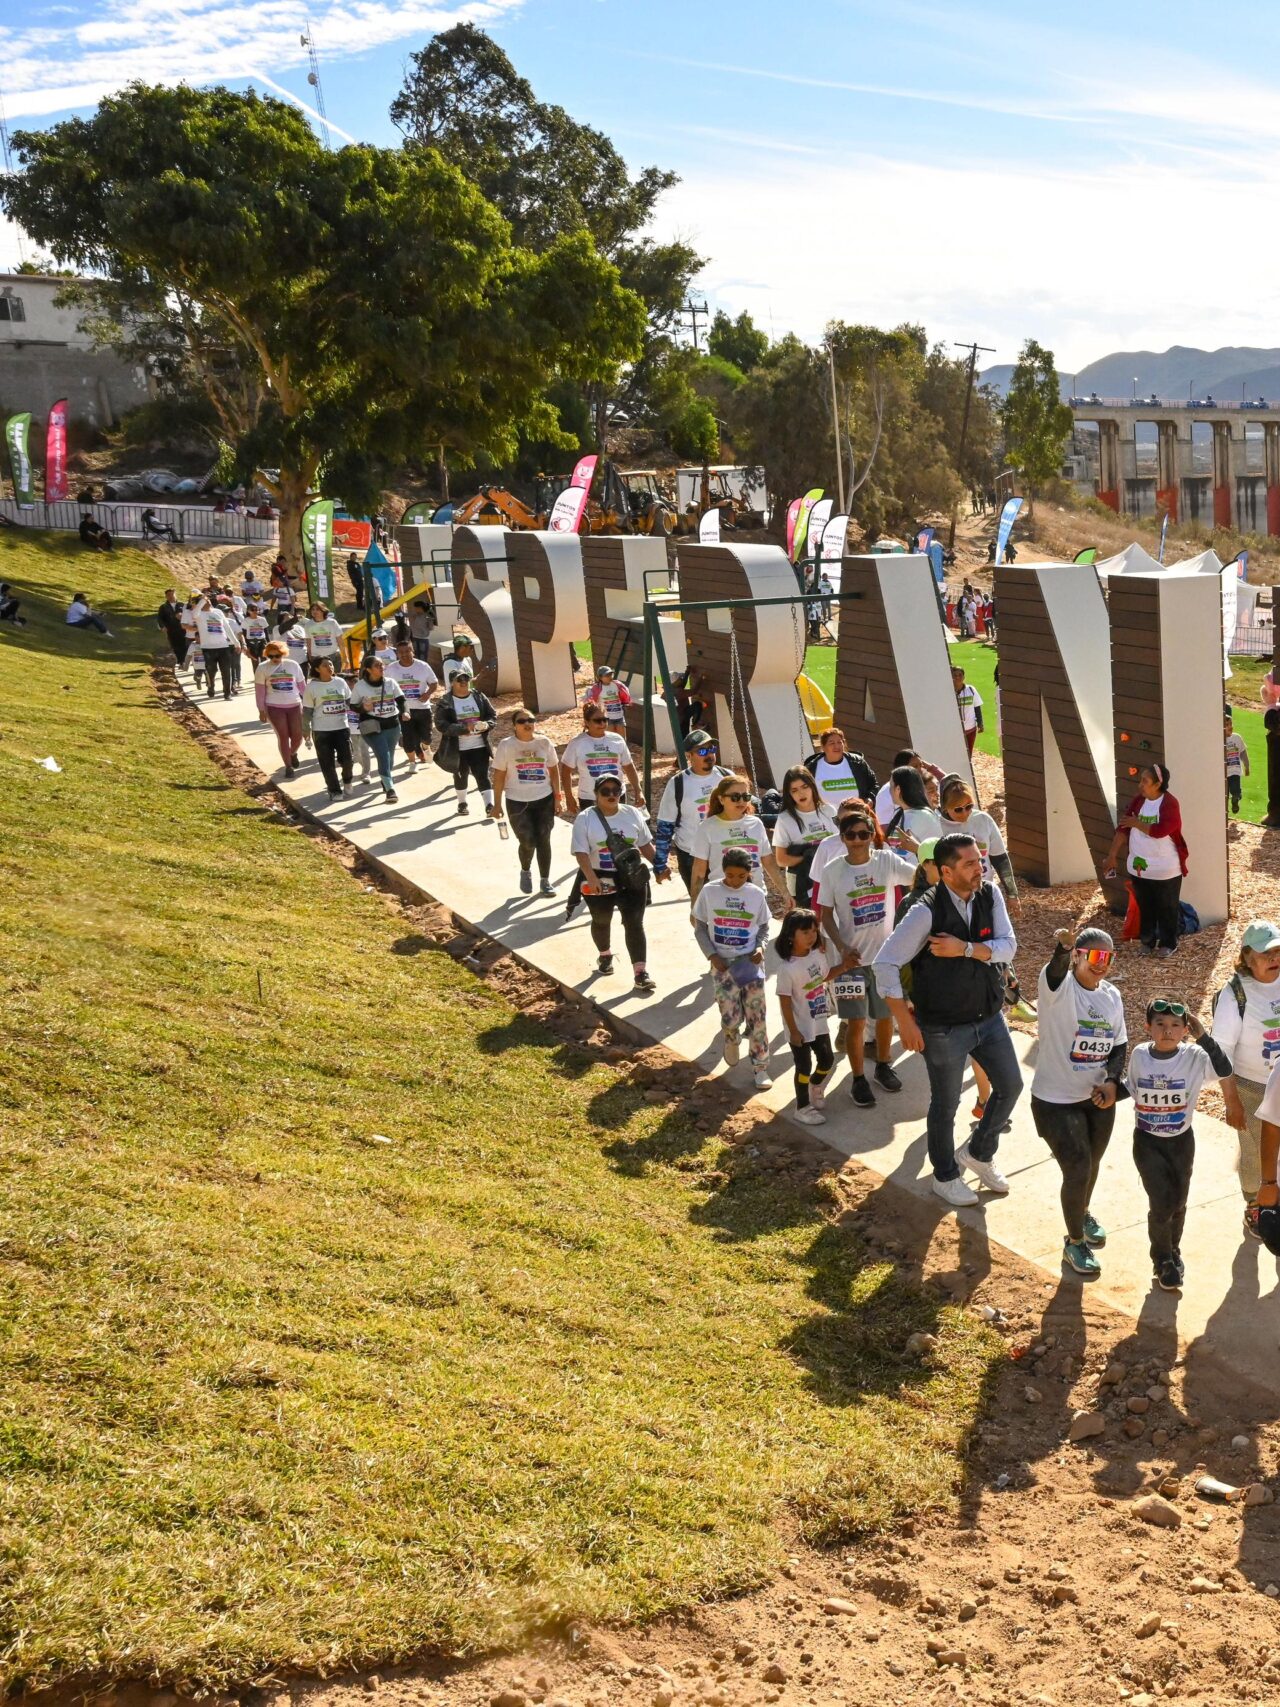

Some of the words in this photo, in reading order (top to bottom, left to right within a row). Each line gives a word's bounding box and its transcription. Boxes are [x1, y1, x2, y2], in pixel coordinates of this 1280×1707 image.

[835, 985, 862, 994] 0956
[1079, 1040, 1111, 1053] 0433
[1141, 1093, 1181, 1105] 1116
